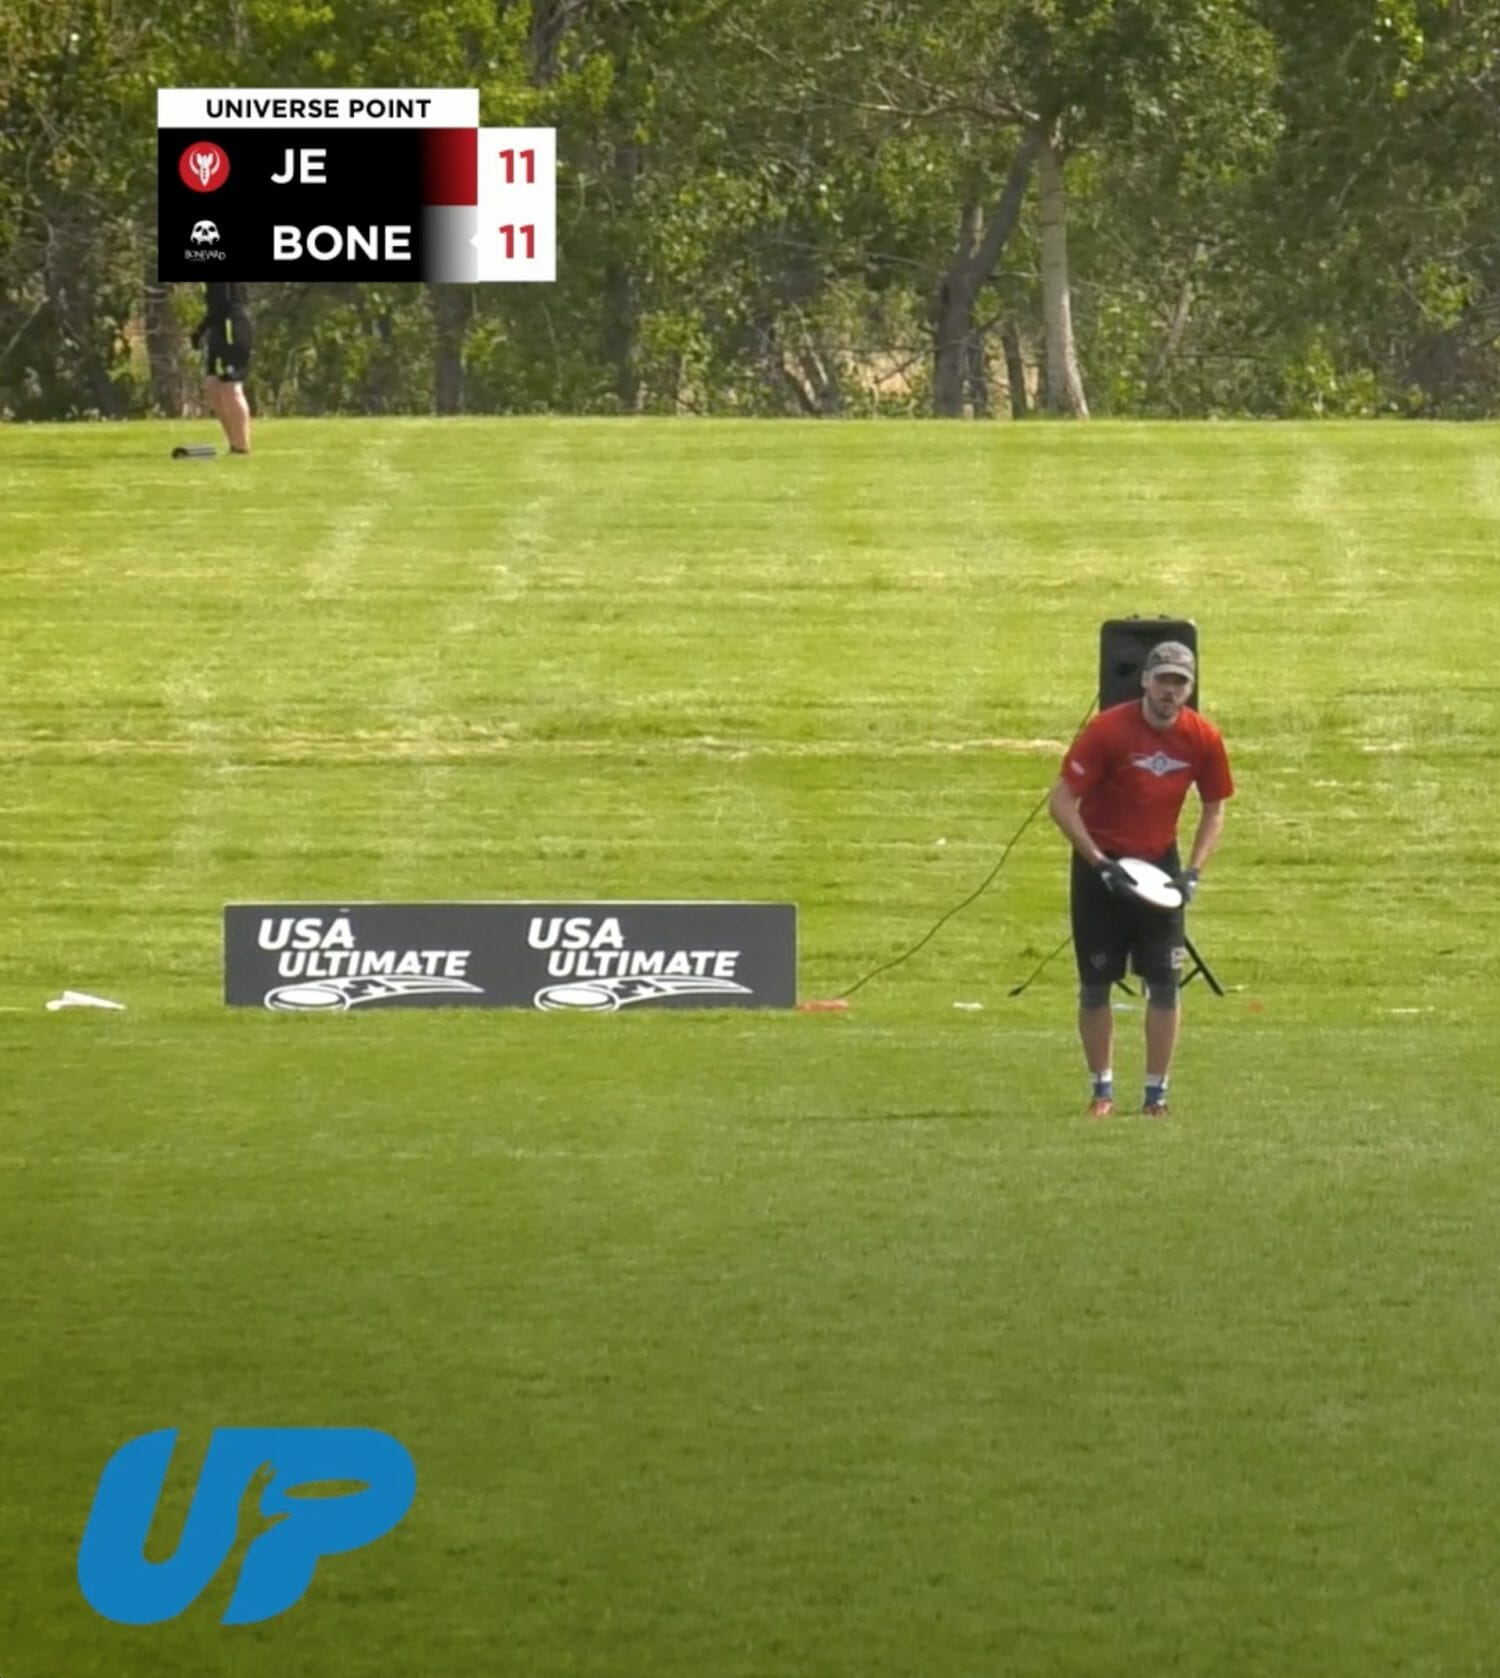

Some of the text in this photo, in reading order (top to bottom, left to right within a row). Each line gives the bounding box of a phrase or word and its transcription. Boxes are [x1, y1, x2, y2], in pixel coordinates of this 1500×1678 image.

[257, 917, 355, 950] USA
[527, 917, 624, 949] USA
[278, 950, 471, 977] ULTIMATE
[548, 950, 740, 977] ULTIMATE
